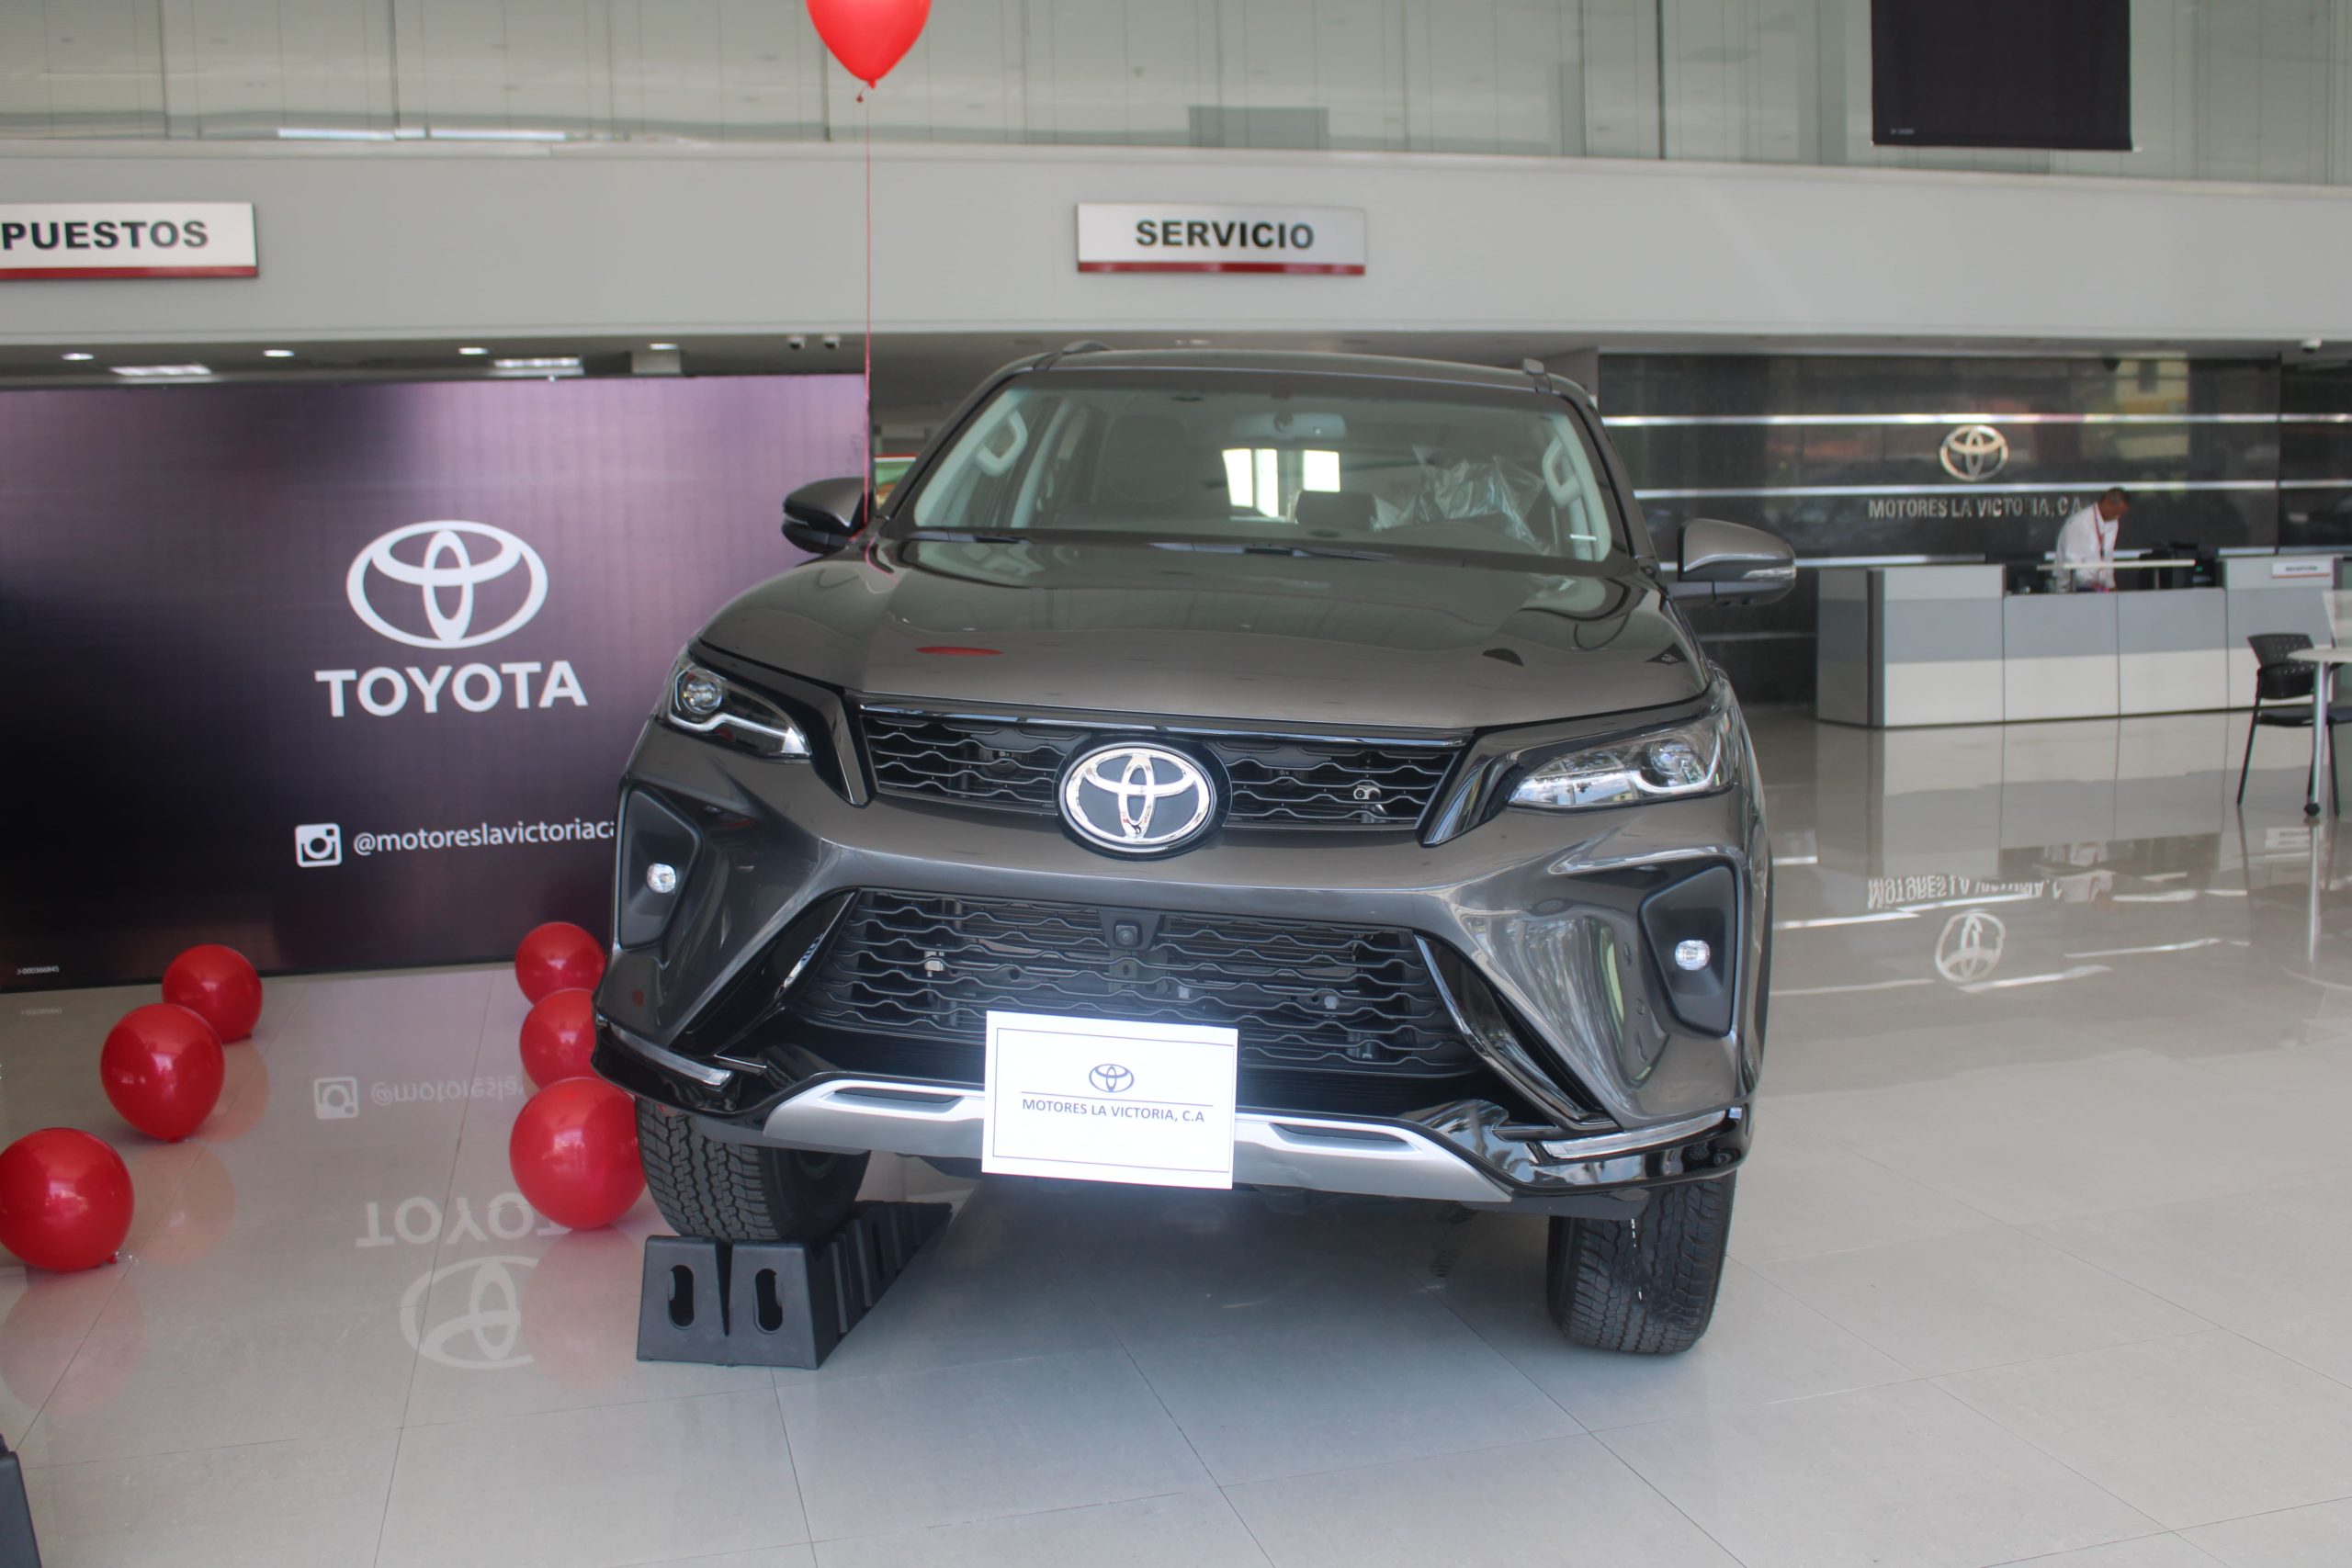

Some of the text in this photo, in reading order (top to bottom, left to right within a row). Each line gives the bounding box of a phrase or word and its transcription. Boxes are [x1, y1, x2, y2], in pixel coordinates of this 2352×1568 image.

[2, 220, 209, 250] PUESTOS
[1136, 220, 1315, 250] SERVICIO
[1868, 497, 1949, 518] MOTORES
[1951, 497, 1973, 517] LA
[1977, 496, 2054, 518] VICTOIA,
[314, 660, 589, 717] TOYOTA
[1022, 1099, 1204, 1122] MOTORES LA VICTORIA, C.A
